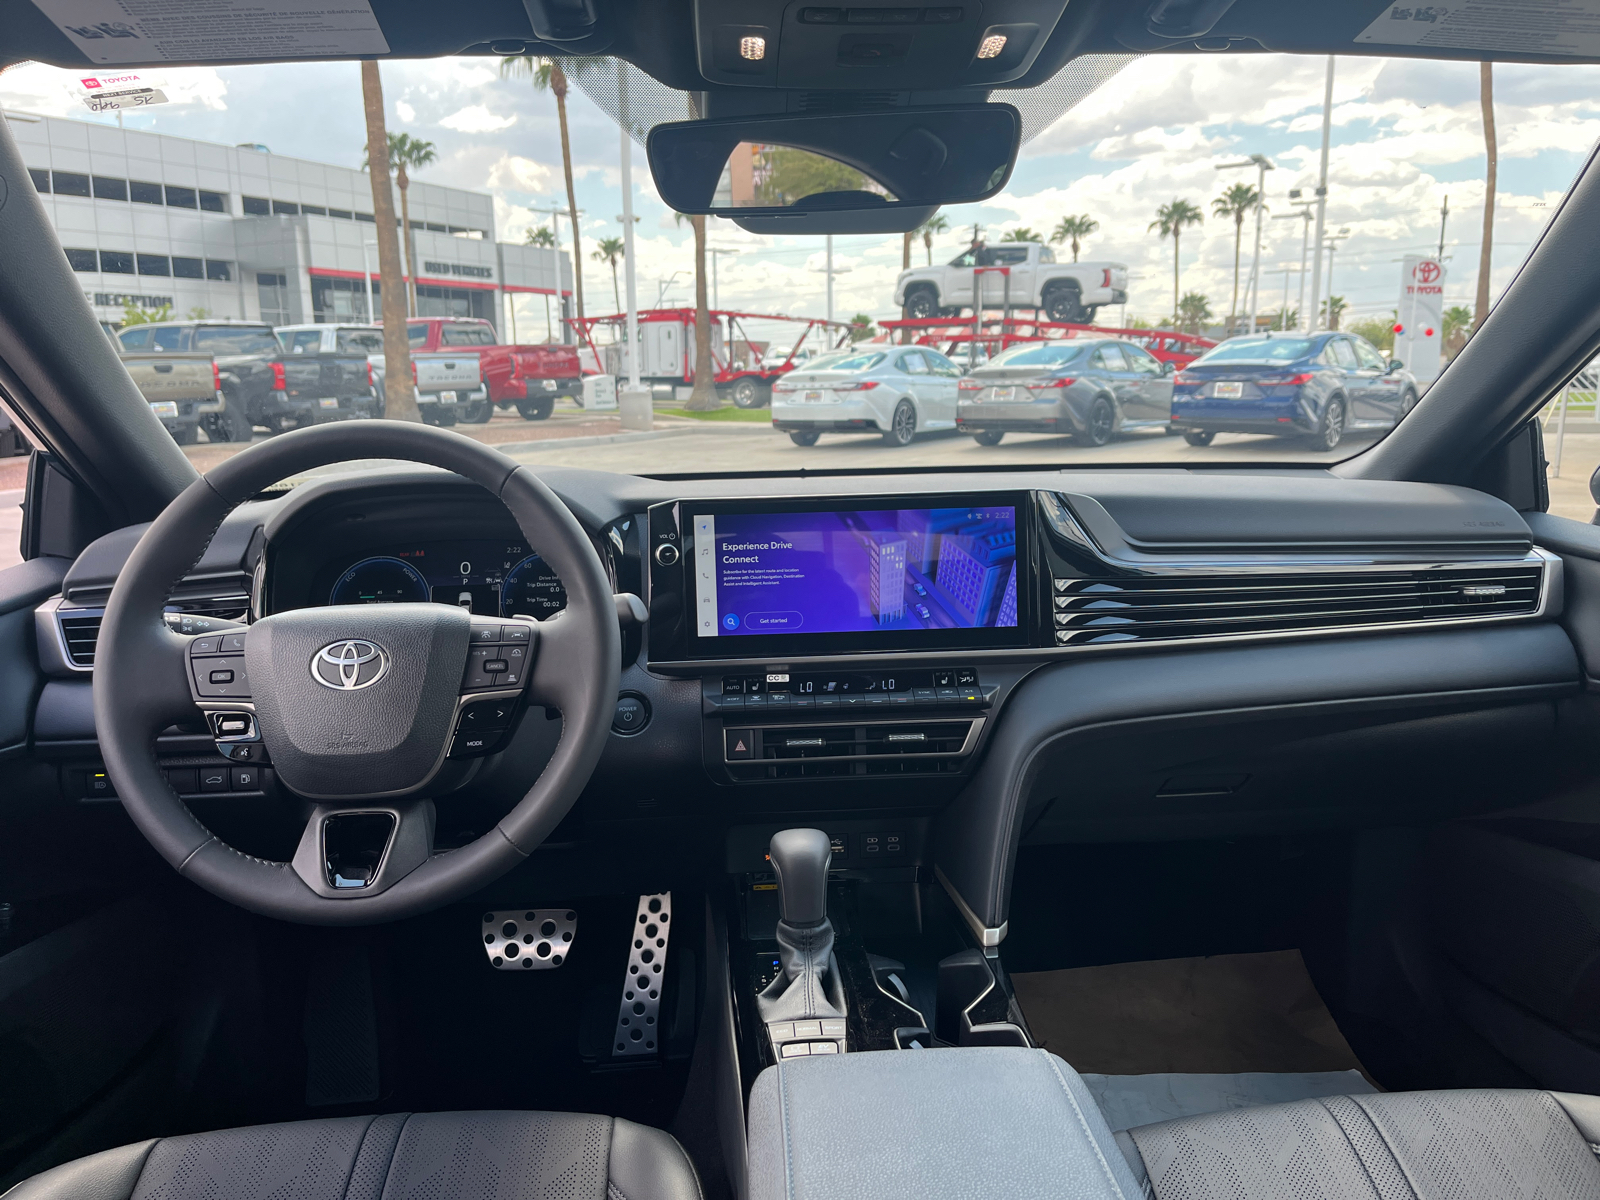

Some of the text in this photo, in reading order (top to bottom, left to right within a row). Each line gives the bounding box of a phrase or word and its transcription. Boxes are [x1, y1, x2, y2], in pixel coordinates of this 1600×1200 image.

[102, 75, 140, 84] TOYOTA
[722, 541, 793, 552] Experience Drive
[723, 556, 759, 564] Connect
[460, 562, 471, 575] 0
[345, 571, 356, 582] ECO
[402, 567, 418, 582] POWER
[800, 682, 812, 692] LO
[882, 679, 895, 690] LO
